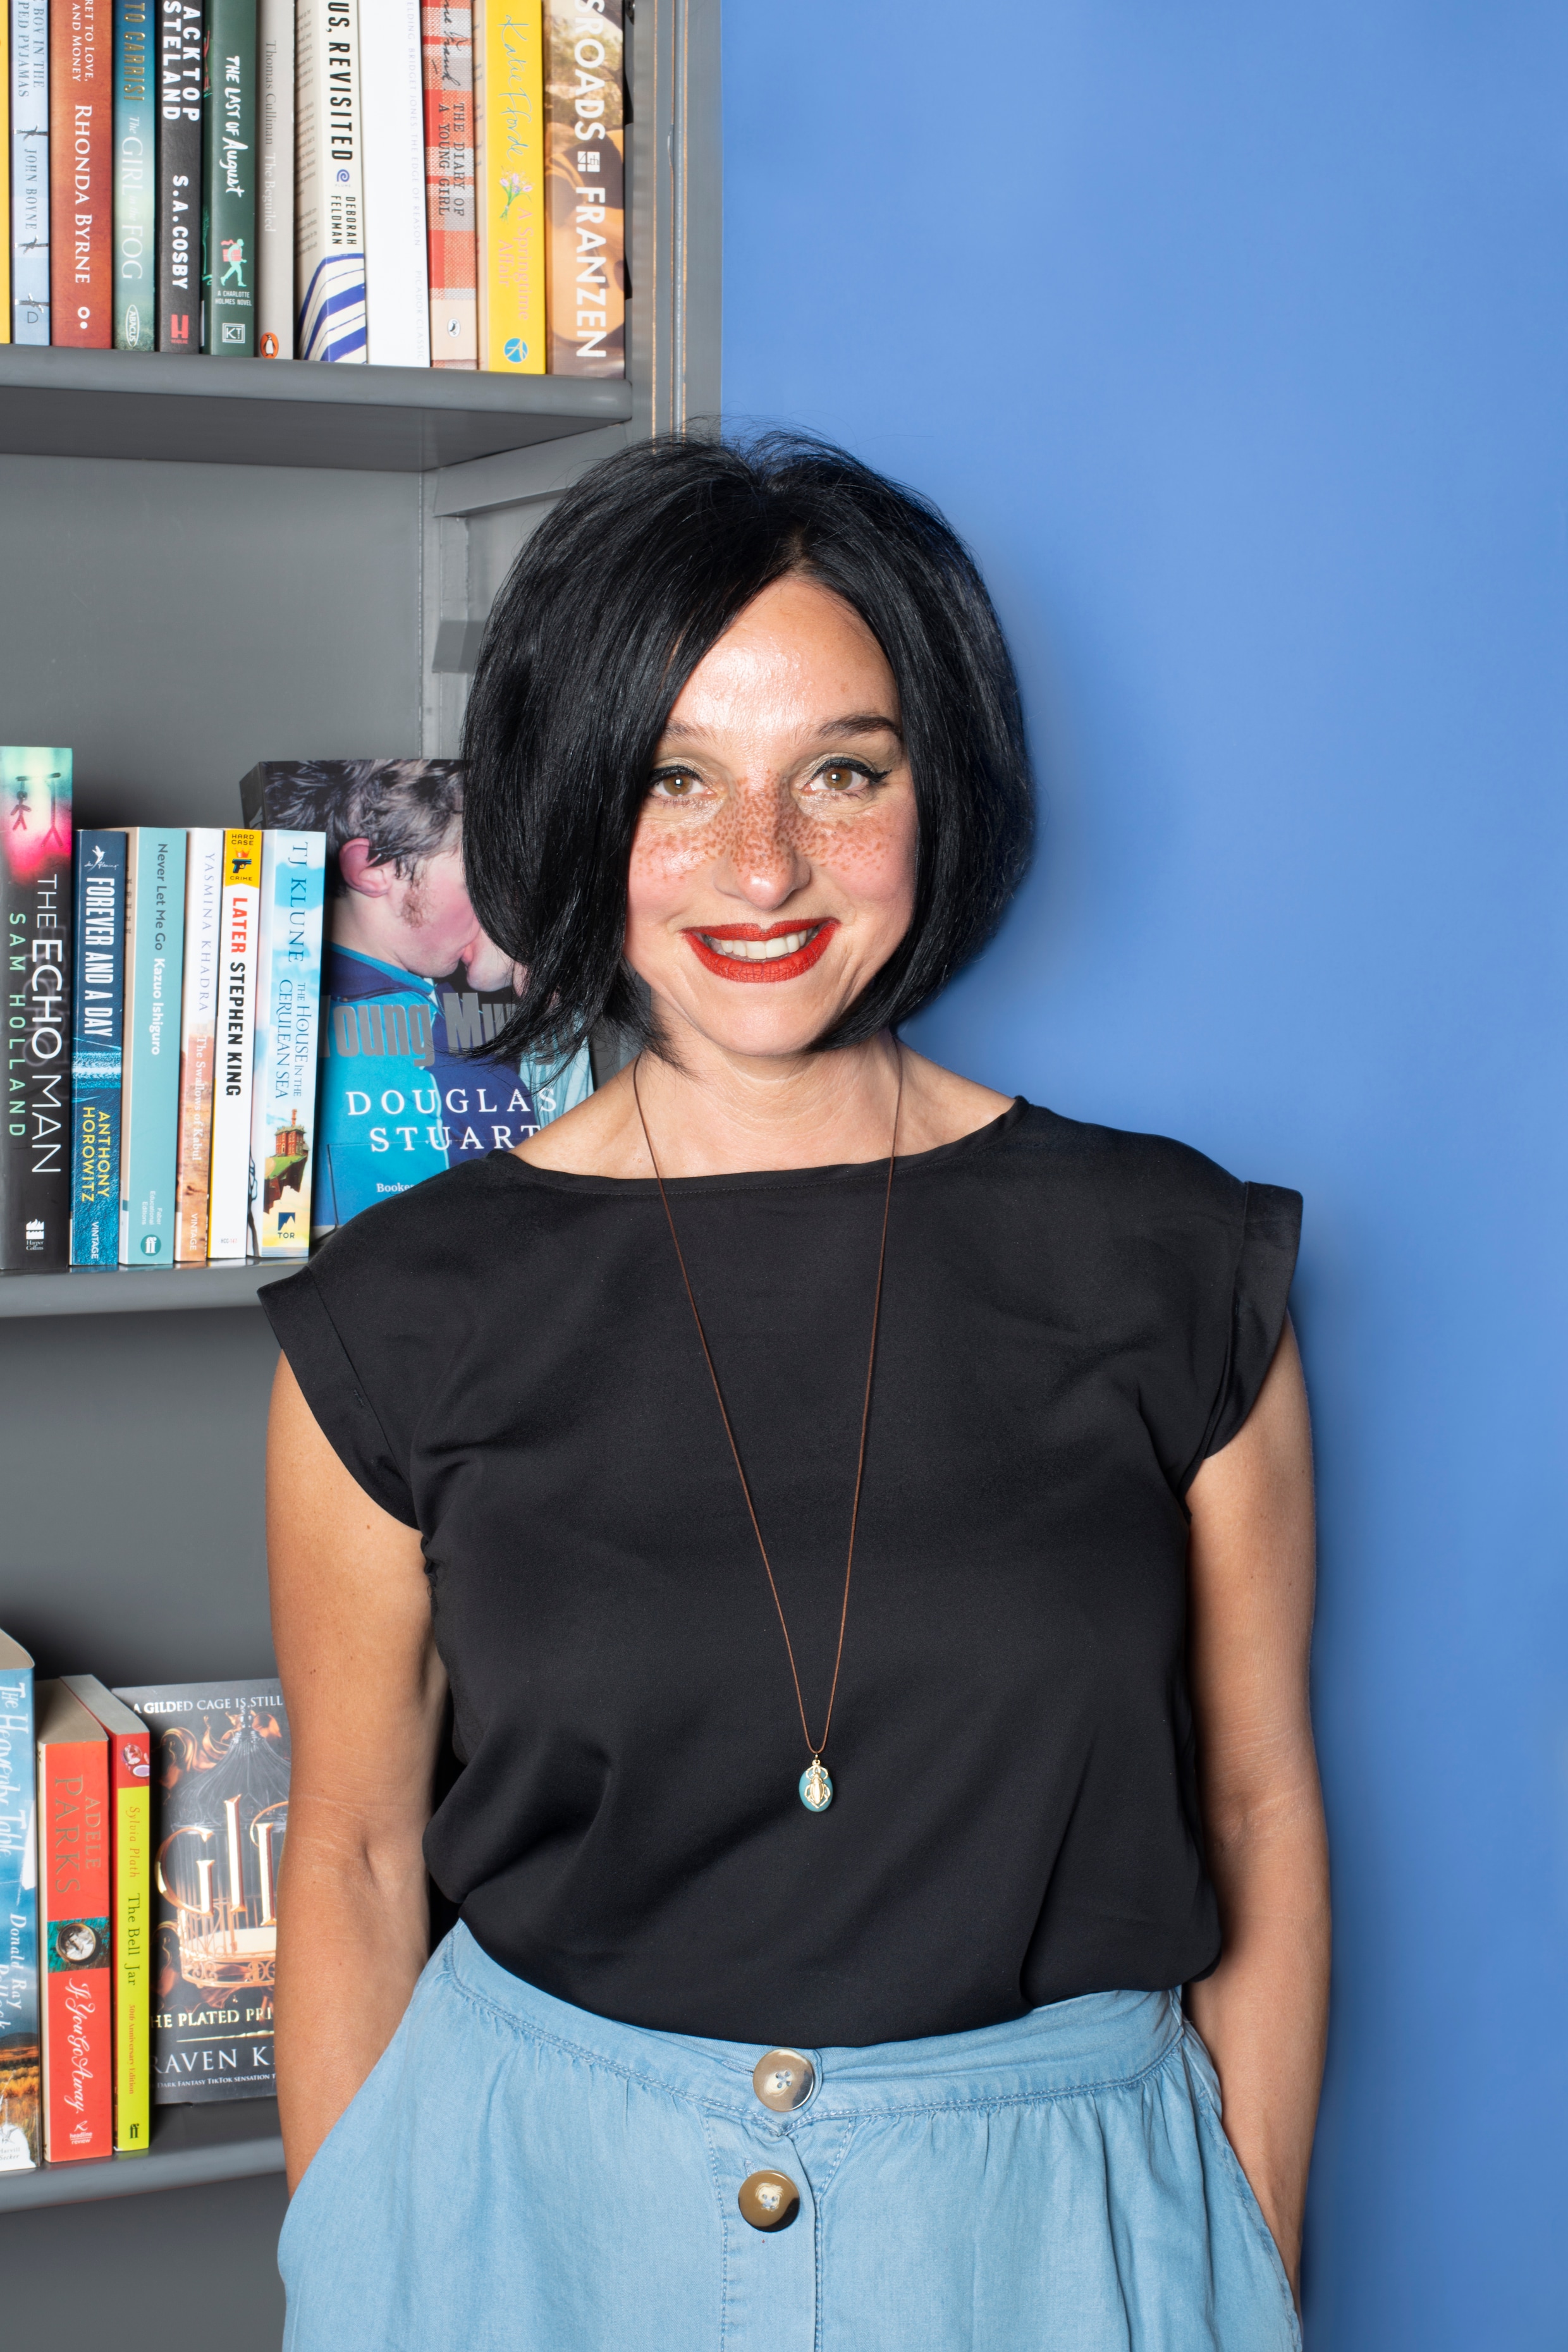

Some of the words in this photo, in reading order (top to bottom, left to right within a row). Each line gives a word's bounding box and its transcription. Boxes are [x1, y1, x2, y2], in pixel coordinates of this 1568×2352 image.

[18, 2, 30, 28] PED
[34, 8, 45, 35] BOY
[72, 3, 81, 31] AND
[85, 0, 94, 20] RET
[124, 3, 146, 23] TO
[407, 1, 415, 40] ELDING
[34, 40, 45, 56] IN
[85, 25, 94, 42] TO
[18, 35, 30, 97] PYJAMAS
[34, 61, 45, 88] THE
[72, 35, 82, 82] MONEY
[84, 47, 95, 82] LOVE,
[124, 32, 146, 101] CARRISI
[162, 1, 182, 120] STELAND
[182, 5, 201, 121] ACKTOP
[225, 56, 241, 83] THE
[265, 40, 277, 89] Thomas
[408, 47, 417, 91] BRIDGET
[574, 0, 606, 140] SROADS
[224, 87, 242, 119] LAST
[264, 93, 278, 145] Cullinan
[329, 42, 353, 161] REVISITED
[439, 104, 451, 113] A
[453, 102, 465, 132] THE
[129, 116, 140, 134] The
[225, 121, 240, 137] OF
[410, 133, 419, 152] THE
[24, 149, 38, 181] JOHN
[75, 104, 92, 205] RHONDA
[264, 152, 277, 178] The
[439, 123, 451, 169] YOUNG
[122, 136, 144, 195] GIRL
[219, 136, 248, 198] August
[411, 156, 420, 183] EDGE
[453, 141, 465, 190] DIARY
[25, 188, 38, 230] BOYNE
[262, 180, 277, 232] Beguiled
[412, 187, 420, 200] OF
[439, 178, 451, 216] GIRL
[453, 197, 465, 216] OF
[129, 205, 139, 221] the
[331, 195, 343, 245] FELDMAN
[345, 197, 357, 245] DEBORAH
[413, 205, 421, 246] REASON
[517, 207, 533, 221] A
[75, 214, 92, 283] BYRNE
[122, 224, 144, 280] FOG
[499, 239, 515, 288] Affair
[513, 226, 534, 321] Springtime
[575, 187, 607, 358] FRANZEN
[215, 298, 235, 306] HOLMES
[237, 298, 252, 307] NOVEL
[223, 290, 250, 298] CHARLOTTE
[414, 270, 423, 314] PICADOR
[128, 310, 136, 342] ABACUS
[415, 319, 425, 360] CLASSIC
[156, 843, 169, 881] Never
[288, 842, 309, 866] TJ
[37, 873, 58, 928] THE
[156, 886, 168, 905] Let
[202, 852, 216, 931] YASMINA
[85, 878, 115, 945] FOREVER
[155, 910, 167, 929] Me
[231, 897, 248, 953] LATER
[288, 878, 307, 962] KLUNE
[9, 912, 27, 971] SAM
[154, 933, 166, 952] Go
[85, 952, 114, 984] AND
[152, 958, 166, 999] Kazuo
[199, 940, 211, 1012] KHADRA
[32, 940, 63, 1059] ECHO
[84, 989, 113, 1000] A
[228, 962, 246, 1045] STEPHEN
[297, 983, 306, 1001] THE
[84, 1007, 113, 1037] DAY
[149, 1002, 164, 1055] Ishiguro
[276, 979, 293, 1066] CERULEAN
[295, 1006, 312, 1062] HOUSE
[9, 995, 26, 1136] HOLLAND
[196, 1036, 207, 1058] The
[194, 1060, 207, 1112] Swallows
[226, 1052, 242, 1096] KING
[275, 1071, 290, 1099] SEA
[293, 1078, 302, 1097] THE
[294, 1065, 304, 1075] IN
[193, 1113, 204, 1127] of
[346, 1087, 558, 1116] DOUGLAS
[32, 1075, 62, 1172] MAN
[82, 1107, 96, 1203] HOROWITZ
[97, 1110, 111, 1197] ANTHONY
[192, 1128, 204, 1161] Kabul
[90, 1221, 99, 1260] VINTAGE
[145, 1236, 157, 1254] ff
[190, 1213, 198, 1251] VINTAGE
[133, 1703, 142, 1713] A
[144, 1700, 193, 1714] GILDED
[197, 1698, 231, 1710] CAGE
[235, 1697, 246, 1708] IS
[250, 1695, 283, 1708] STILL
[54, 1774, 83, 1894] PARKS
[85, 1796, 101, 1870] ADELE
[125, 1806, 140, 1842] Sylvia
[128, 1847, 140, 1878] Plath
[128, 1892, 140, 1923] The
[10, 1913, 27, 1969] Donald
[128, 1928, 140, 1957] Bell
[64, 1977, 92, 1999] If
[124, 1963, 140, 1986] Jar
[6, 1978, 27, 2010] Ray
[64, 1997, 96, 2035] You
[178, 2009, 240, 2027] PLATED
[246, 2007, 273, 2022] PRI
[67, 2033, 90, 2057] Go
[127, 2023, 137, 2066] Anniversary
[150, 2049, 237, 2074] RAVEN
[64, 2055, 94, 2114] Away
[178, 2079, 206, 2087] FANTASY
[70, 2131, 92, 2139] headline
[129, 2122, 140, 2140] ff
